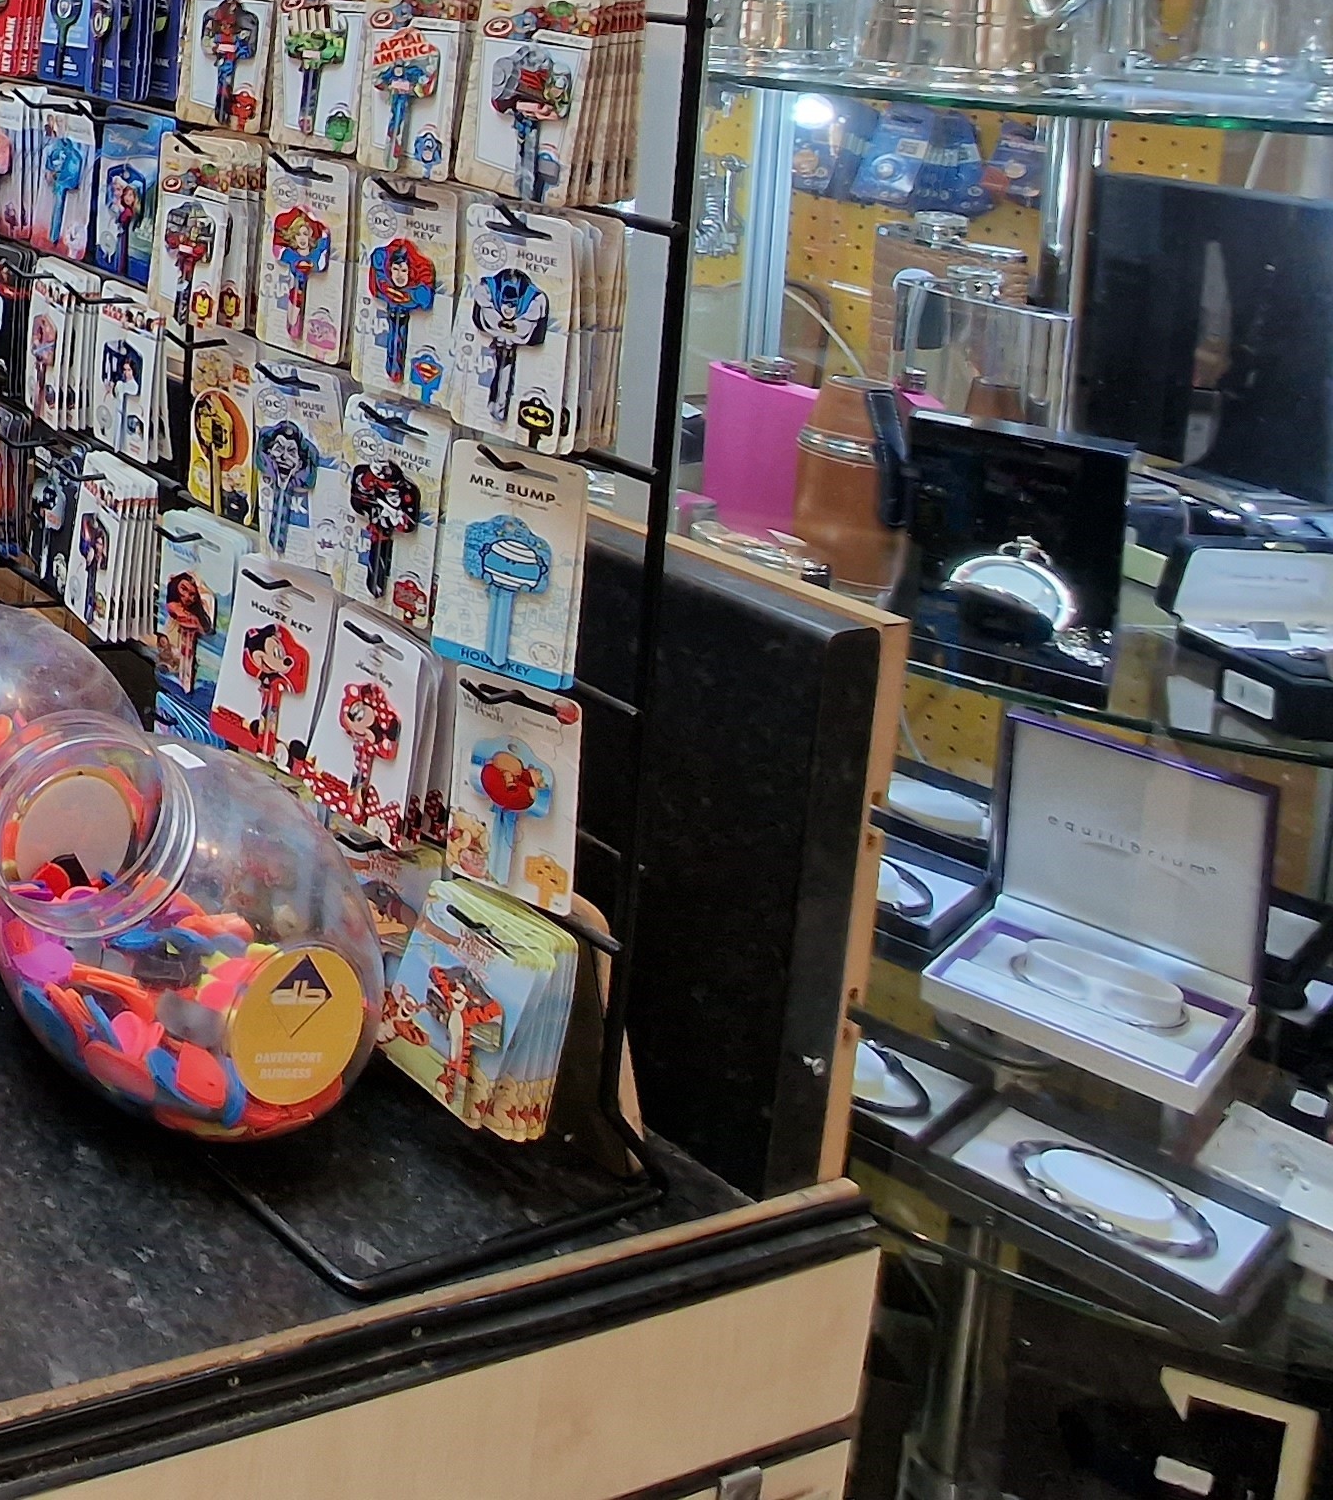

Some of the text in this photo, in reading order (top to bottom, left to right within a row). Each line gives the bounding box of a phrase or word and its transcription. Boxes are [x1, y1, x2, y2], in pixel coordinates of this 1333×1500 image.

[406, 218, 443, 234] HOUSE
[413, 230, 435, 241] KEY
[482, 246, 558, 267] DC HOUSE
[525, 262, 549, 275] KEY
[295, 400, 327, 414] HOUSE
[302, 410, 321, 421] KEY
[393, 447, 432, 468] HOUSE
[400, 459, 423, 474] KEY
[469, 473, 500, 491] MR.
[505, 482, 557, 504] BUMP
[251, 599, 287, 624] HOUSE
[290, 619, 313, 635] KEY
[460, 647, 530, 677] HOU KEY
[1047, 814, 1207, 876] equilibrium
[254, 1051, 323, 1064] DAVENPORT
[259, 1067, 312, 1079] BURGESS
